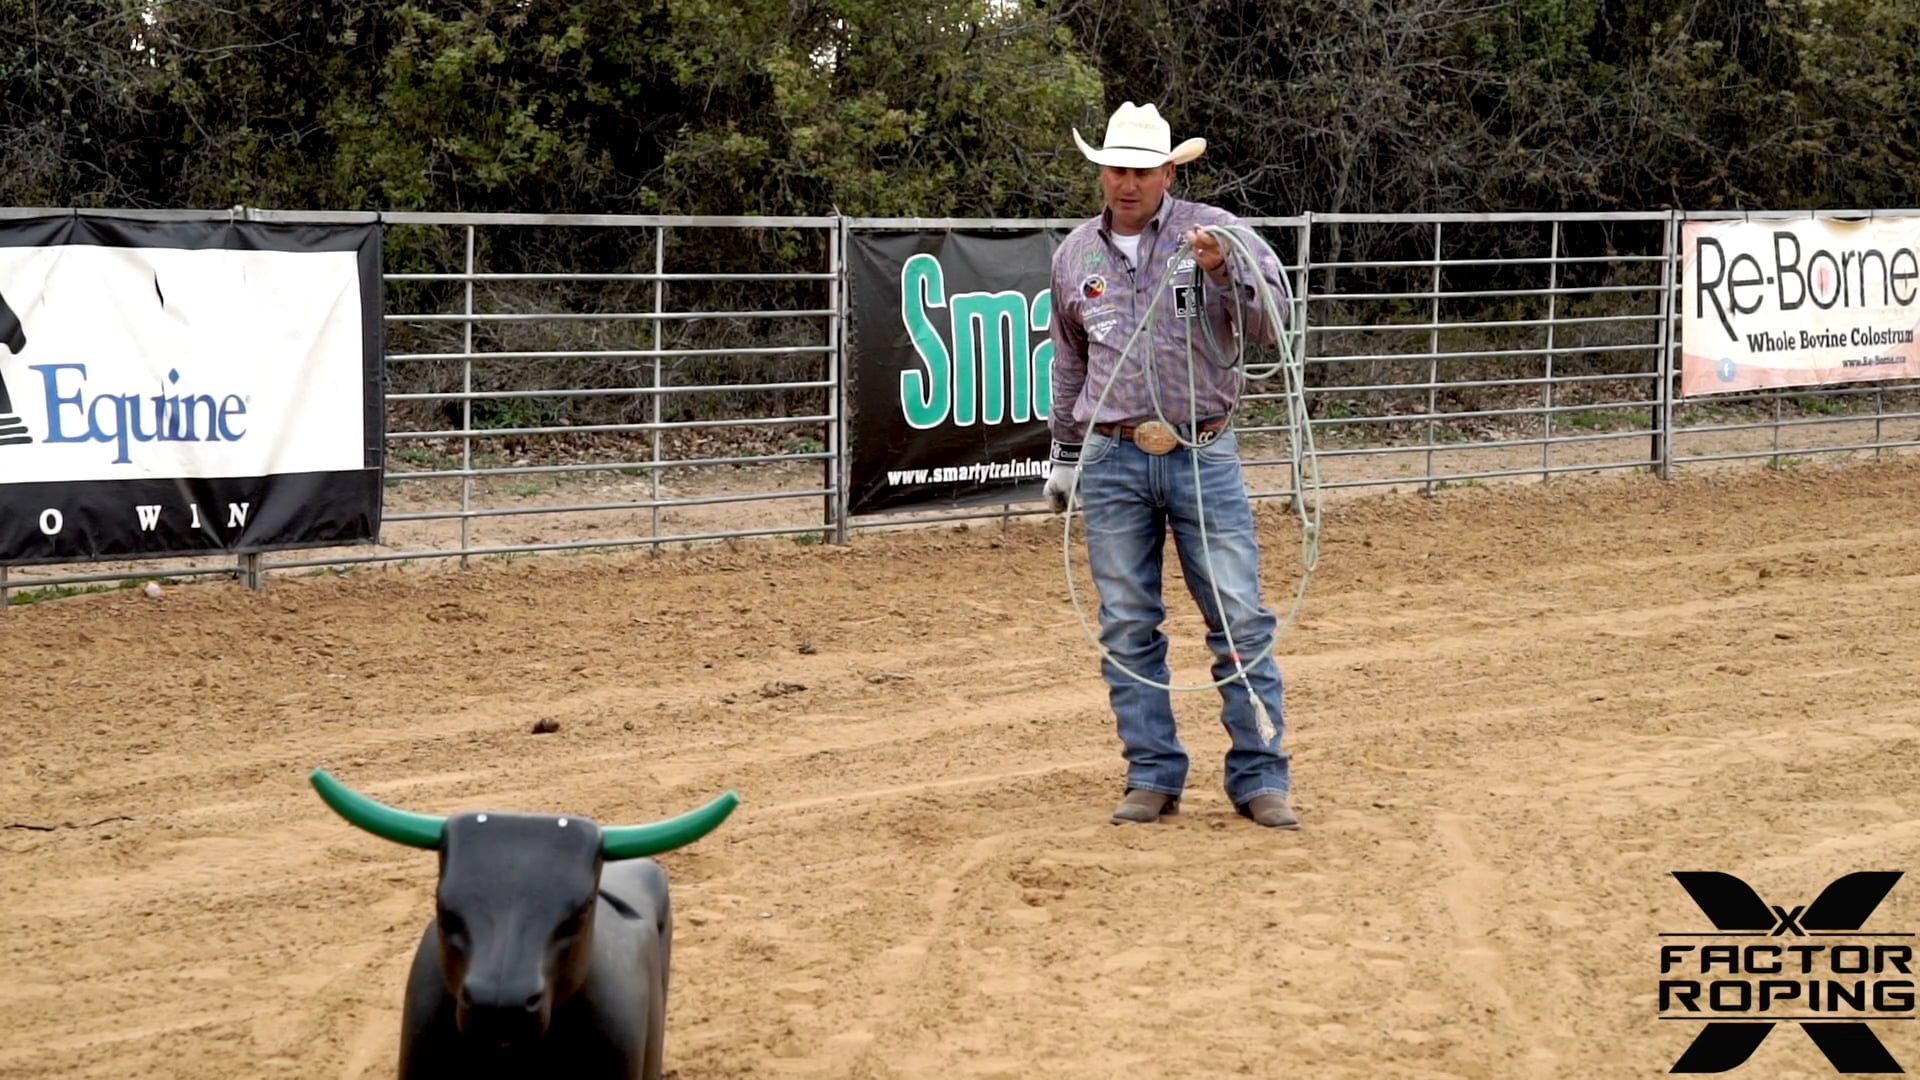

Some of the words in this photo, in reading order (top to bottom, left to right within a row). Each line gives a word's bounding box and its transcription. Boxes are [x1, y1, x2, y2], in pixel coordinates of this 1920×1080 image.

[1696, 231, 1919, 341] Re-Borne
[1747, 331, 1796, 352] Whole
[1800, 328, 1847, 349] Bovine
[1851, 326, 1914, 346] Colostrum
[28, 363, 247, 464] Equine
[39, 508, 63, 535] O
